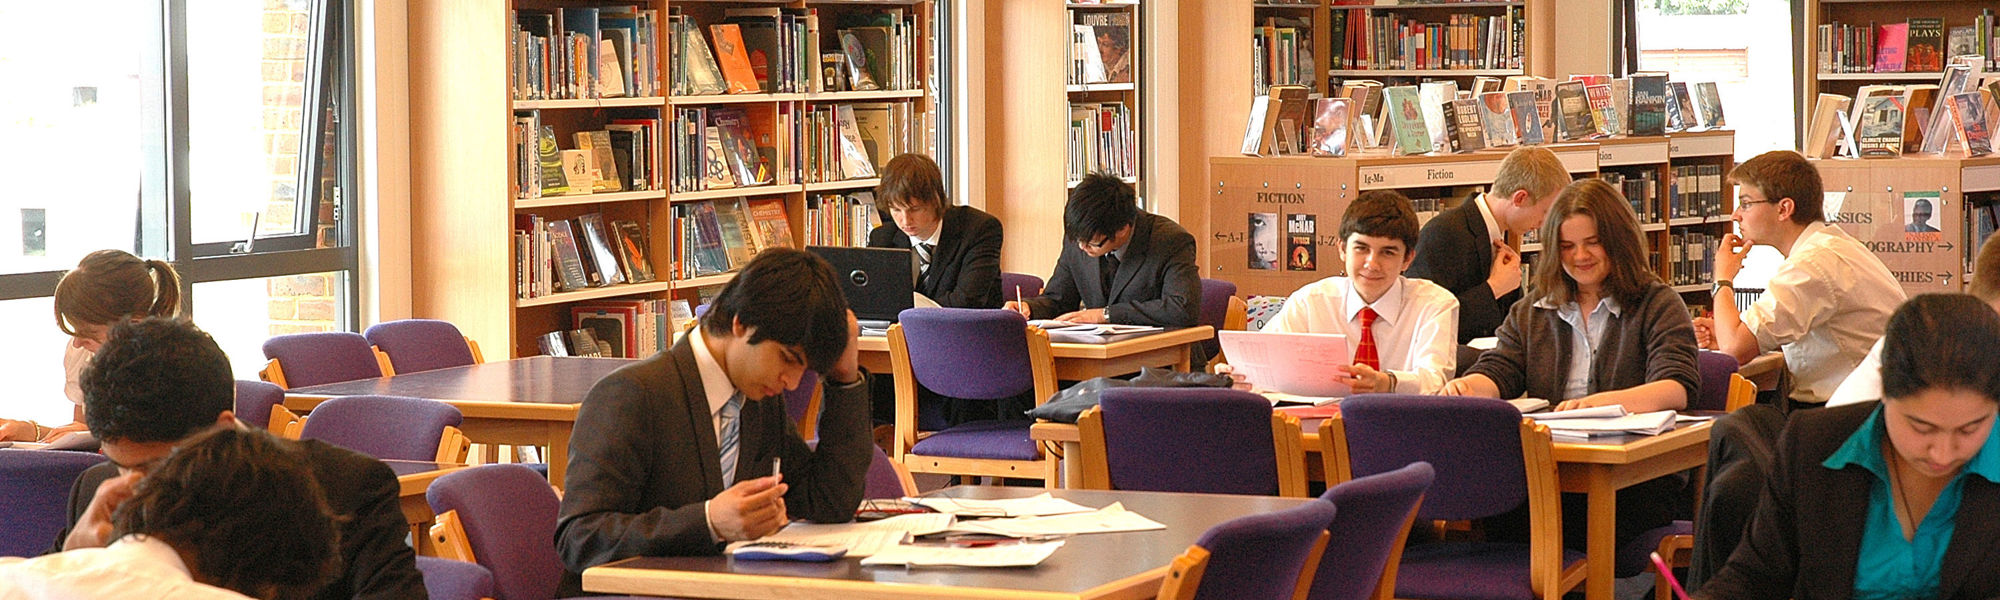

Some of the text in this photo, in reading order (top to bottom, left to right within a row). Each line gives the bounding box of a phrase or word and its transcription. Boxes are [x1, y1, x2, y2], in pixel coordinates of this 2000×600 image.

[1083, 15, 1108, 26] LOUVRE
[1910, 29, 1941, 38] PLAYS
[1535, 90, 1552, 101] cNAB
[1456, 105, 1477, 115] ROBERT
[1364, 168, 1454, 184] Ig-Ma Fiction
[1256, 192, 1305, 204] FICTION
[1288, 220, 1314, 234] McNAB
